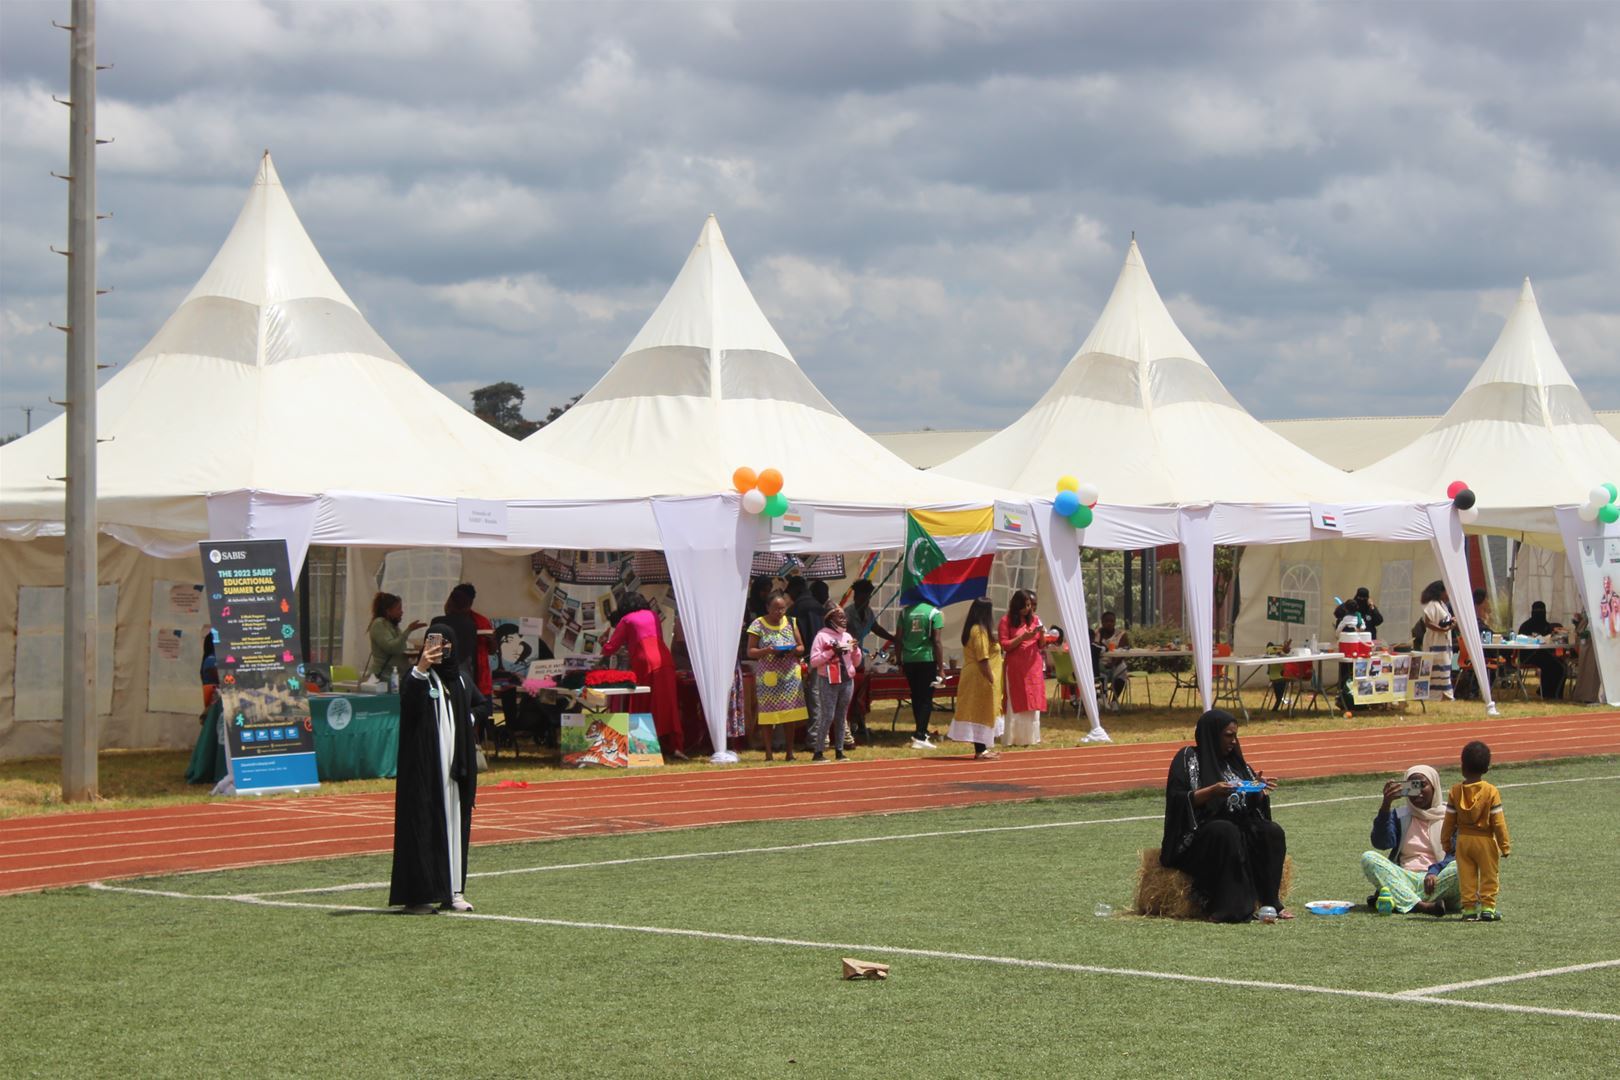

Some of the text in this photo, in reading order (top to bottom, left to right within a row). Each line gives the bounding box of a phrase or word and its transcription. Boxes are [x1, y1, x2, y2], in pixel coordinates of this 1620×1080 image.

[217, 570, 232, 578] THE
[233, 569, 251, 577] 2022
[223, 577, 274, 586] EDUCATIONAL
[223, 585, 276, 595] SUMMER CAMP
